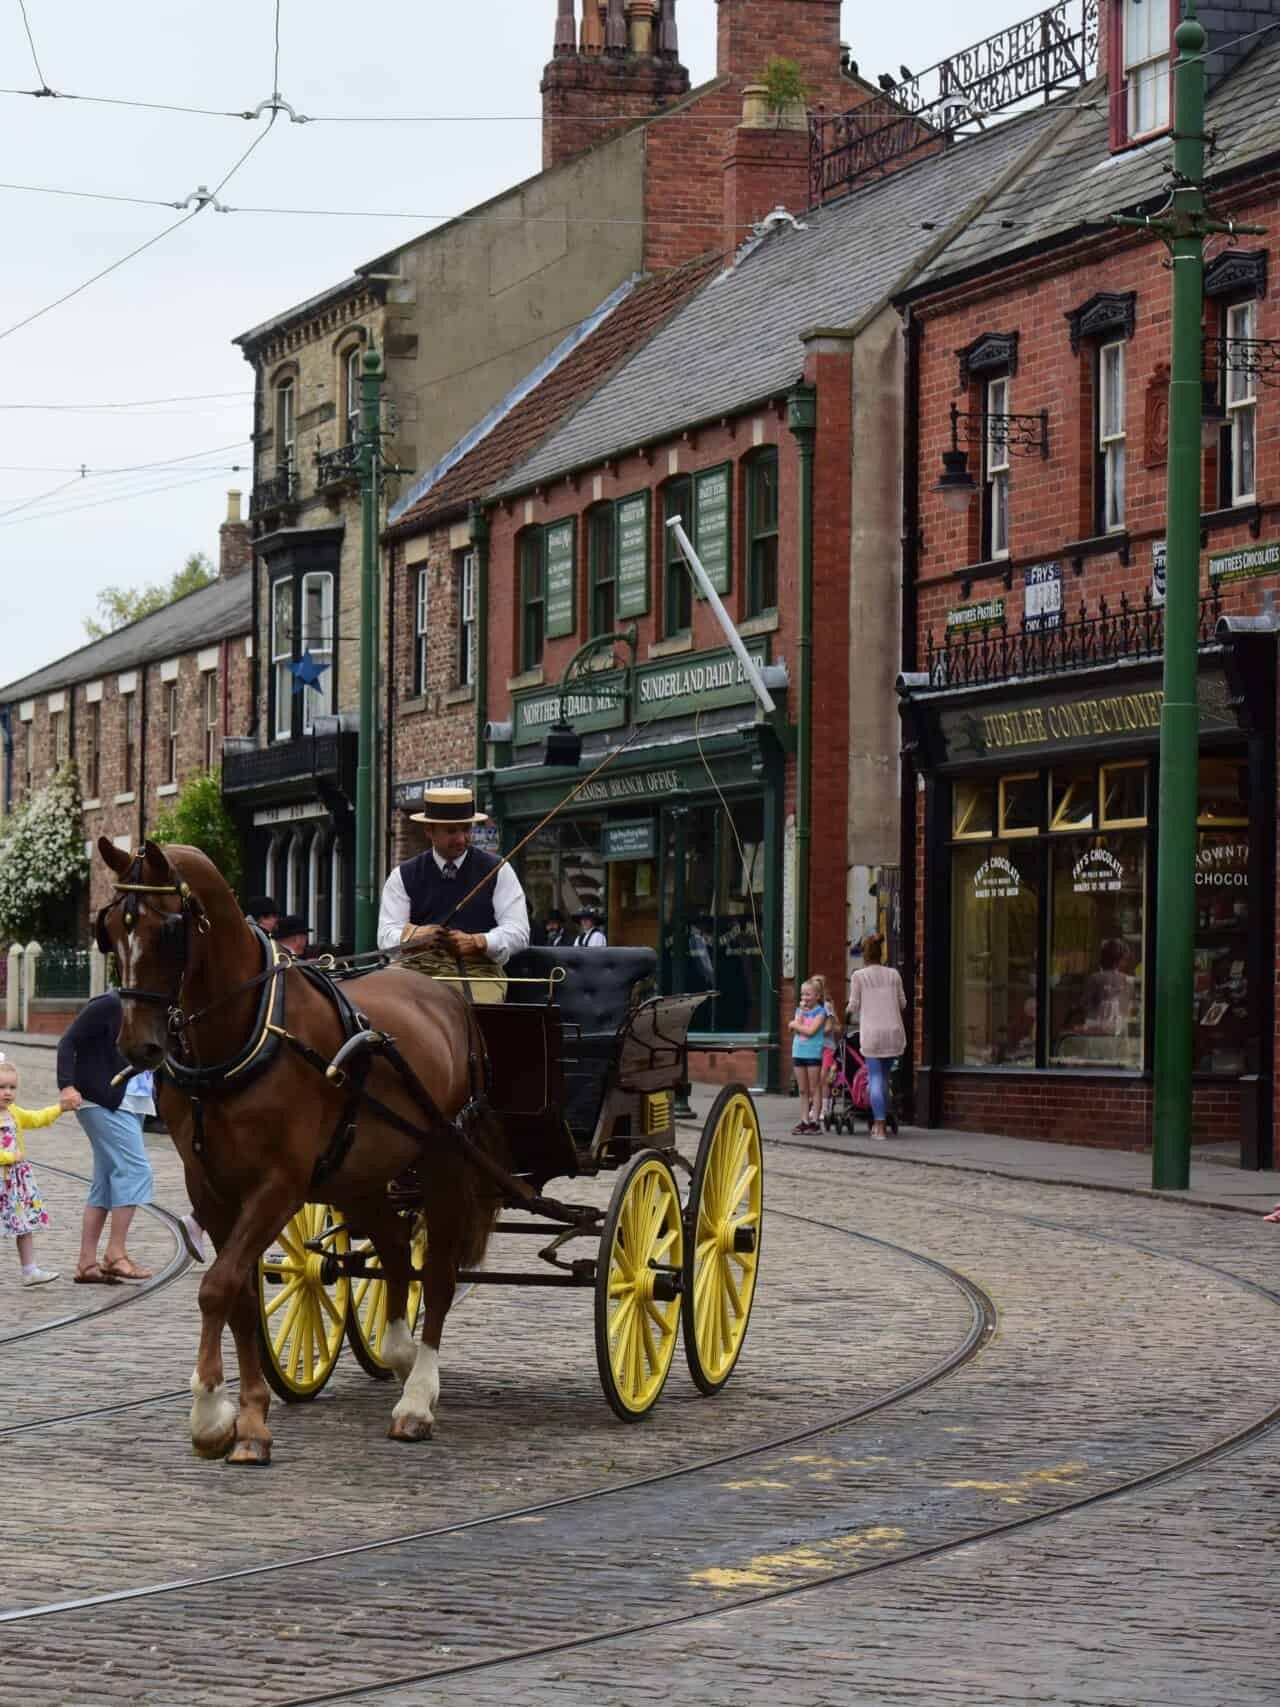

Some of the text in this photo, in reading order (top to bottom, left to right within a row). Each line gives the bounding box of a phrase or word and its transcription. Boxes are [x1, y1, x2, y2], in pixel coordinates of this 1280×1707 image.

[1243, 547, 1280, 570] CHOCOLATES
[639, 656, 763, 701] SUNDERLAND DAILY EO
[522, 696, 566, 724] NORTHER
[567, 696, 593, 716] DAILY
[984, 708, 1048, 748] JUBILEE
[609, 775, 644, 797] BRANCH
[646, 769, 678, 791] OFFICE
